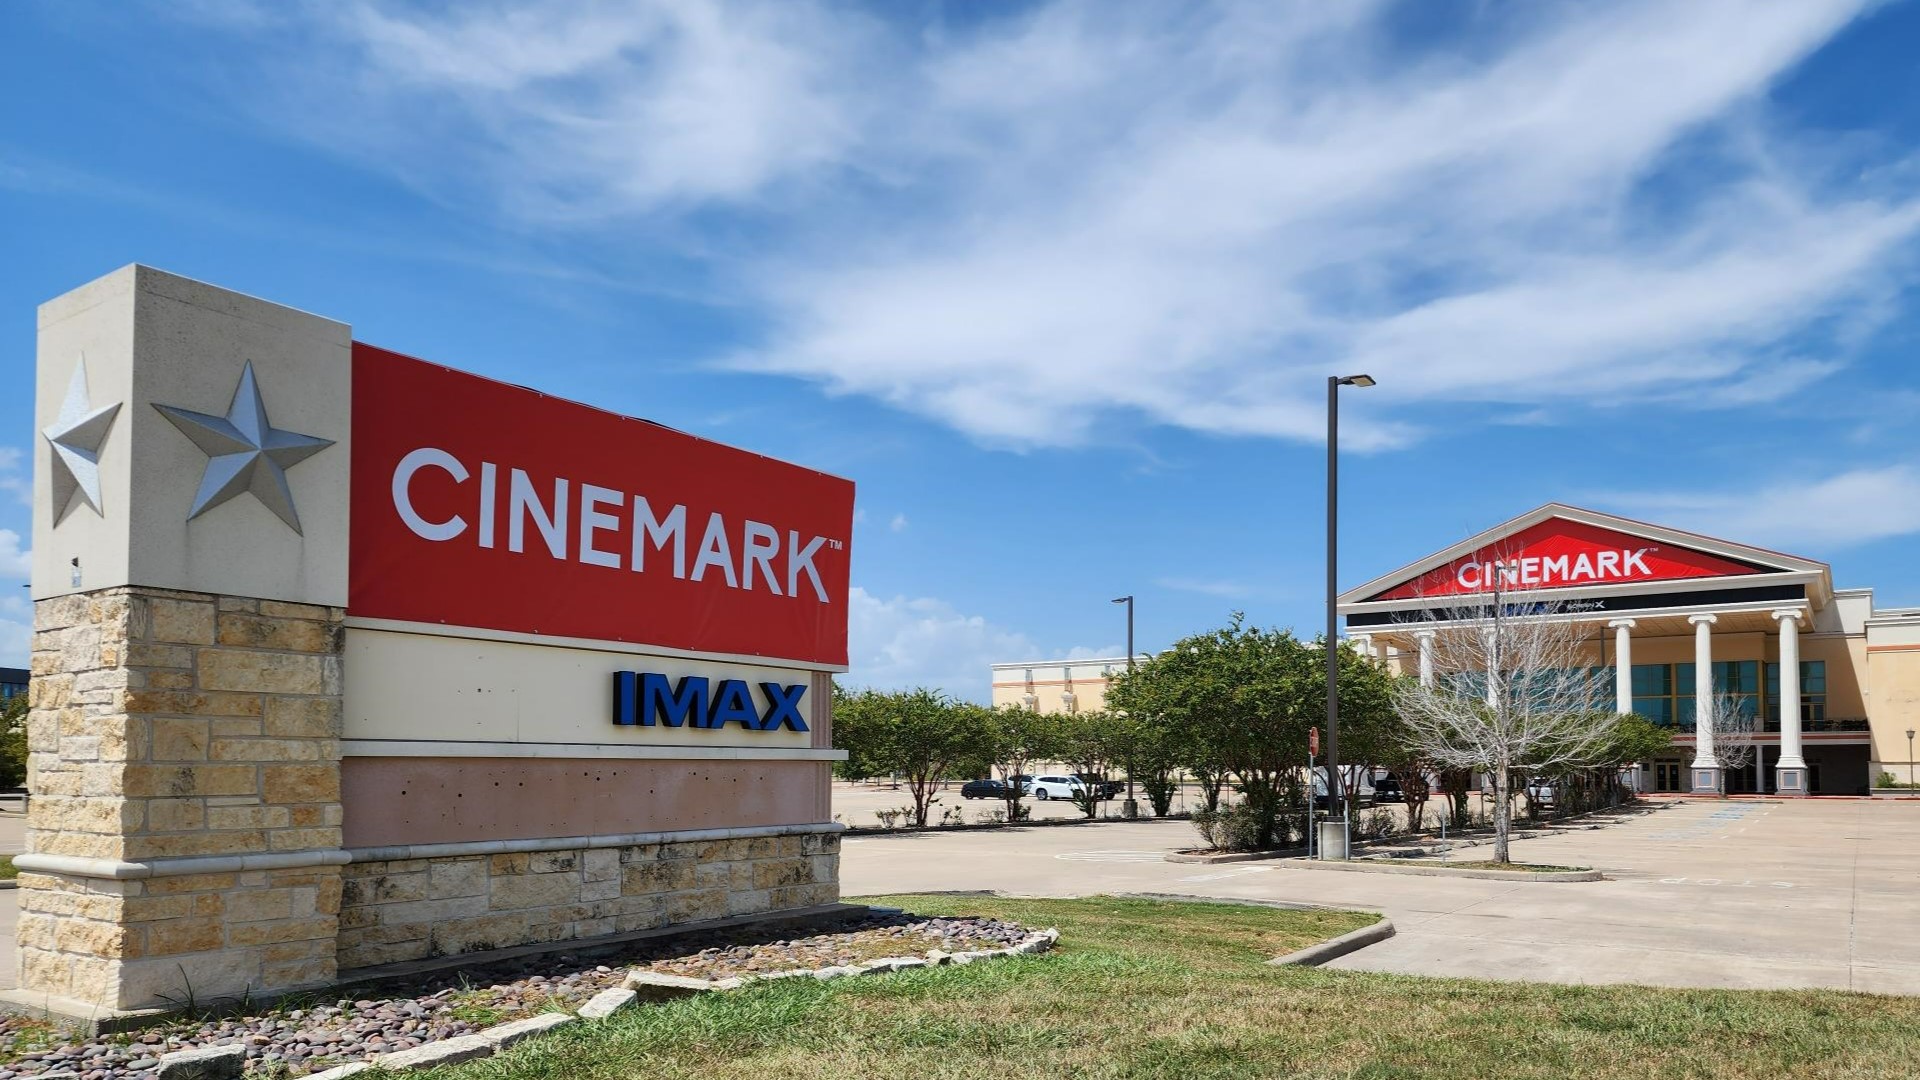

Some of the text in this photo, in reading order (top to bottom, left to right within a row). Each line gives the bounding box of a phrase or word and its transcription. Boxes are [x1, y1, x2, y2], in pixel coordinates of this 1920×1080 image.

[391, 447, 843, 604] CINEMARK TM
[1457, 548, 1653, 588] CINEMARK
[613, 671, 810, 732] IMAX
[1659, 877, 1794, 889] STOP
